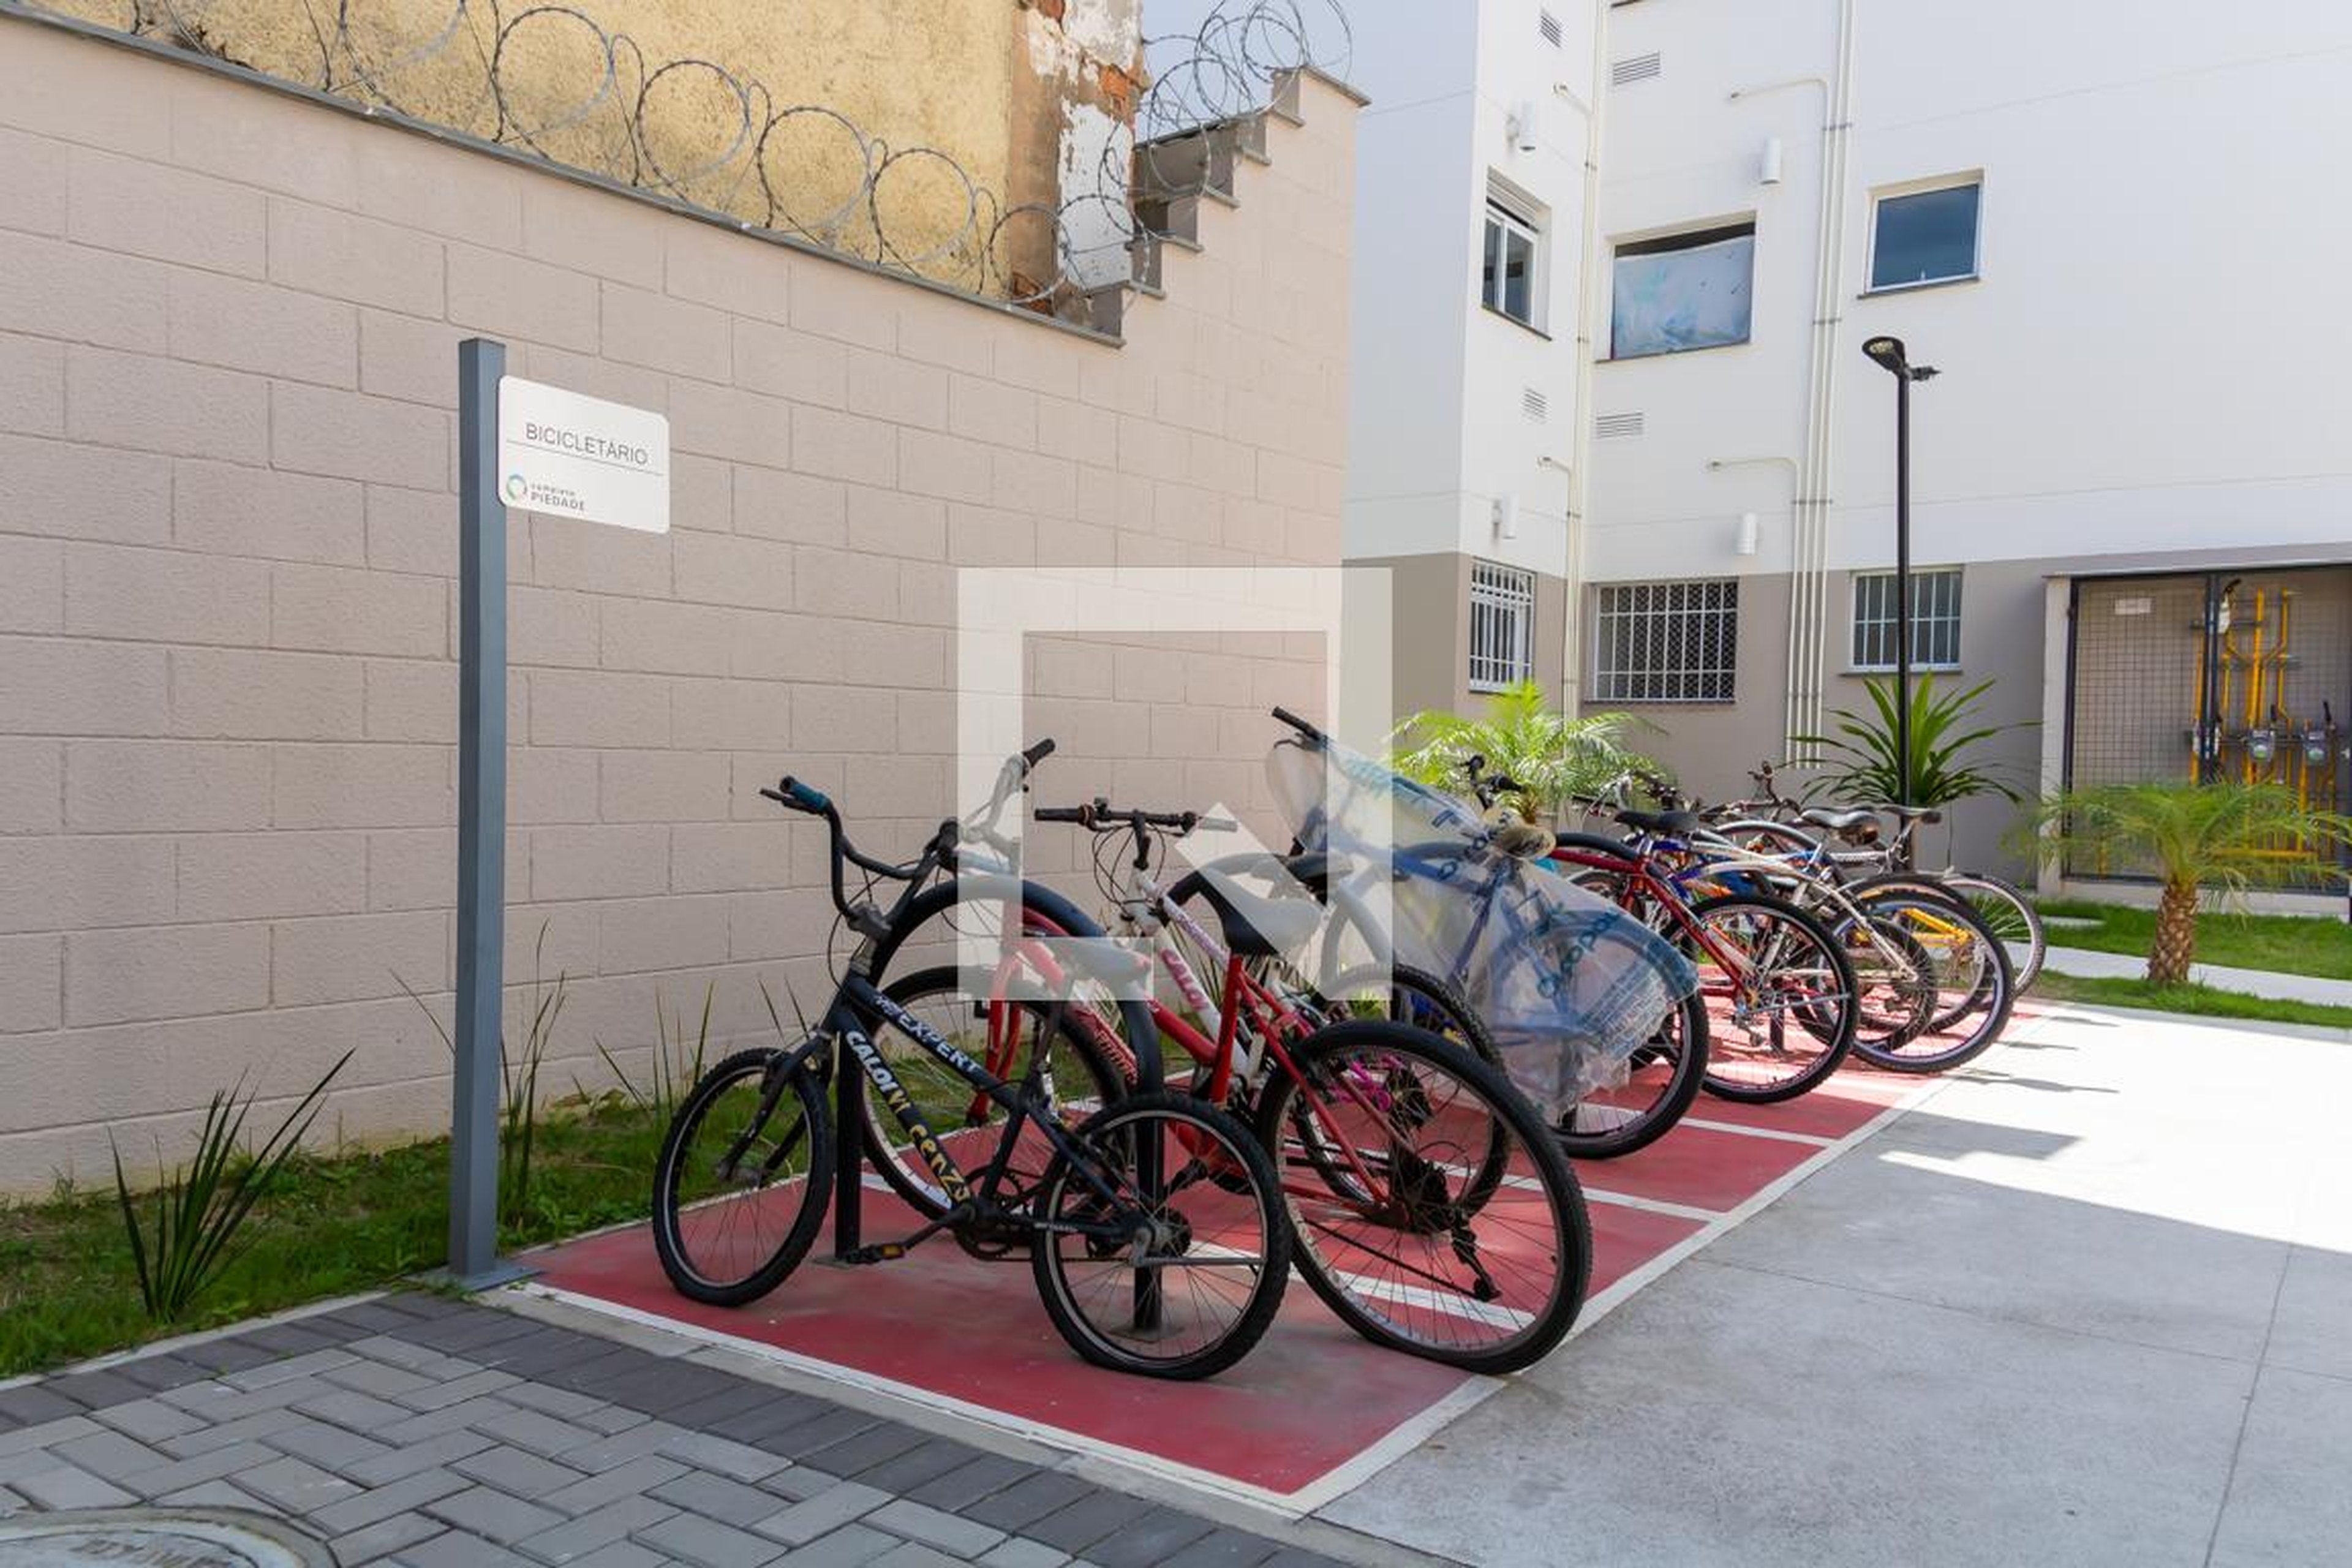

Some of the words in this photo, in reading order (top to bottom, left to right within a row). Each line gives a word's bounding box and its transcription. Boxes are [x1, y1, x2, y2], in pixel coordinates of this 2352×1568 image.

[531, 492, 585, 511] PIEDADE
[845, 1030, 899, 1092] CALOI
[899, 1012, 982, 1072] EXPERT
